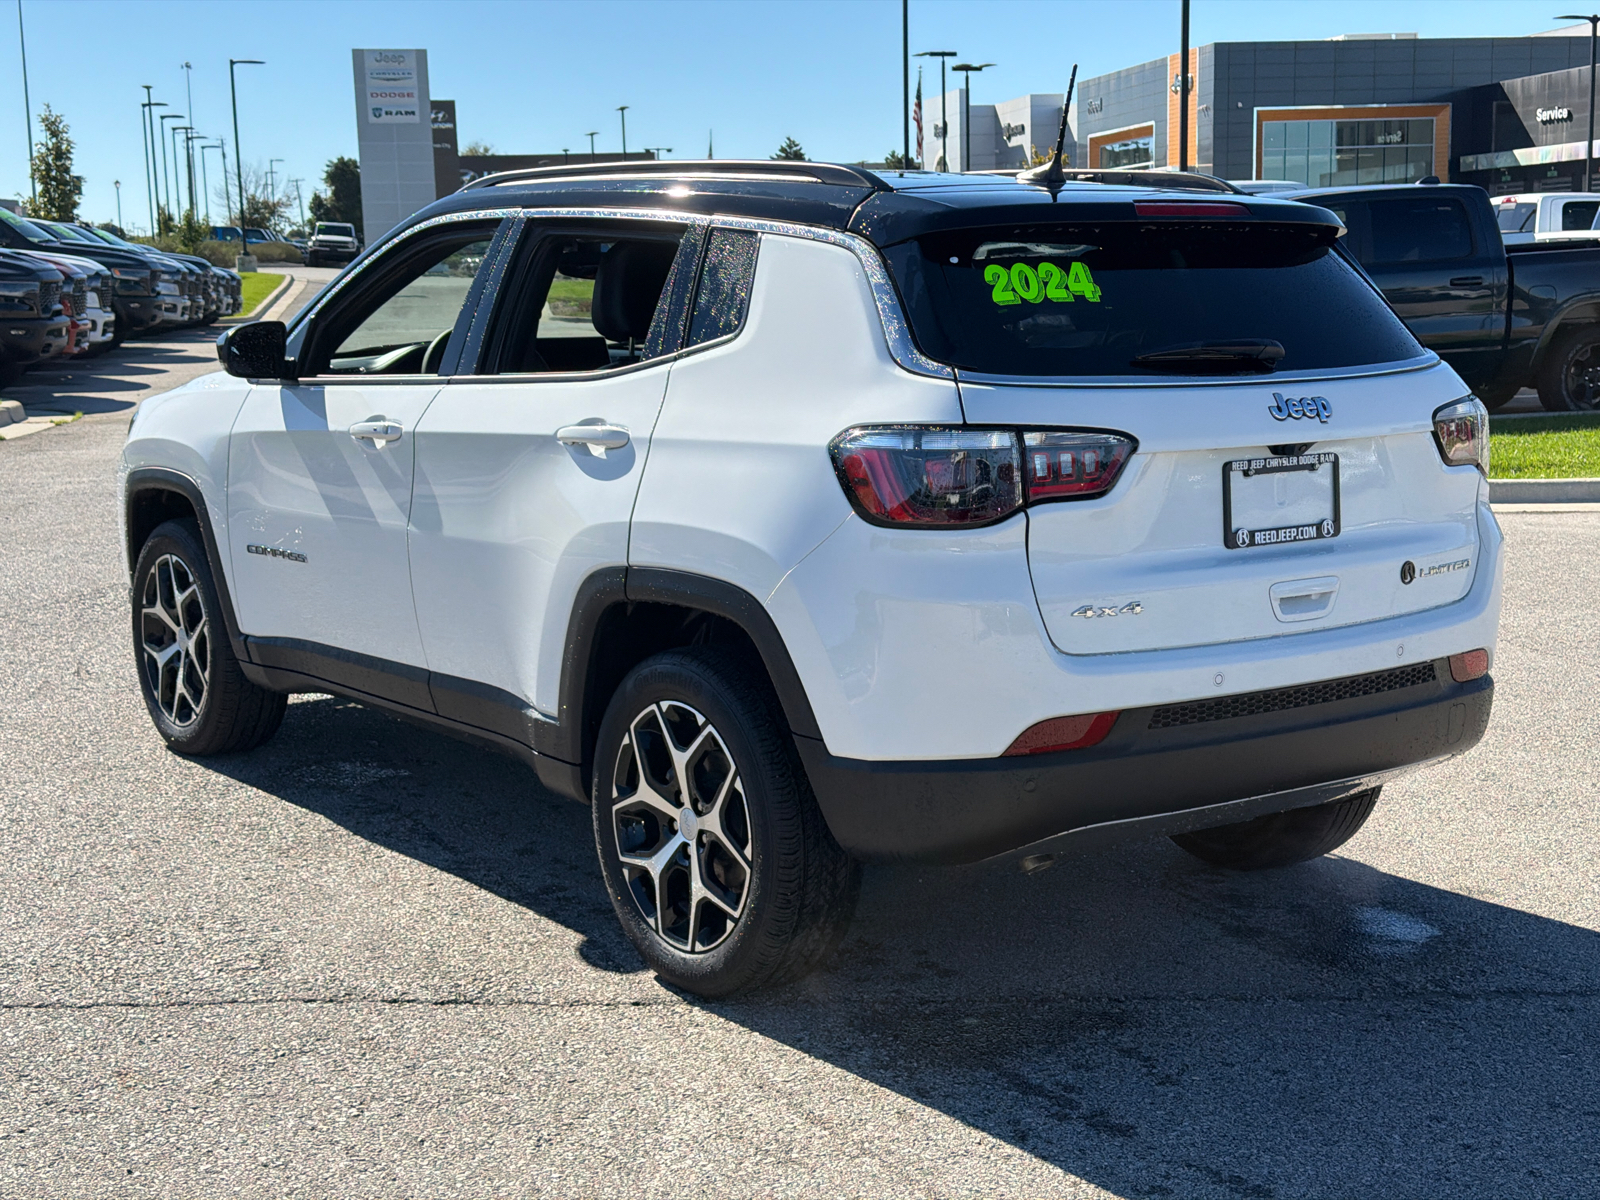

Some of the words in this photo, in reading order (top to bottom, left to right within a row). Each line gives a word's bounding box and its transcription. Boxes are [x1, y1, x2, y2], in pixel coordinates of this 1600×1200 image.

[374, 51, 405, 66] Jeep
[369, 91, 416, 99] DODGE
[384, 109, 416, 117] RAM
[1535, 105, 1569, 123] Service
[983, 261, 1102, 306] 2024
[1267, 392, 1333, 424] Jeep
[1231, 460, 1249, 471] REED
[1249, 459, 1265, 470] JEEP
[1266, 456, 1298, 468] CHRYSLER
[1299, 454, 1319, 465] DODGE
[1320, 453, 1335, 463] RAM
[1254, 525, 1317, 545] REEDJEEP.COM
[246, 544, 309, 564] COMPASS
